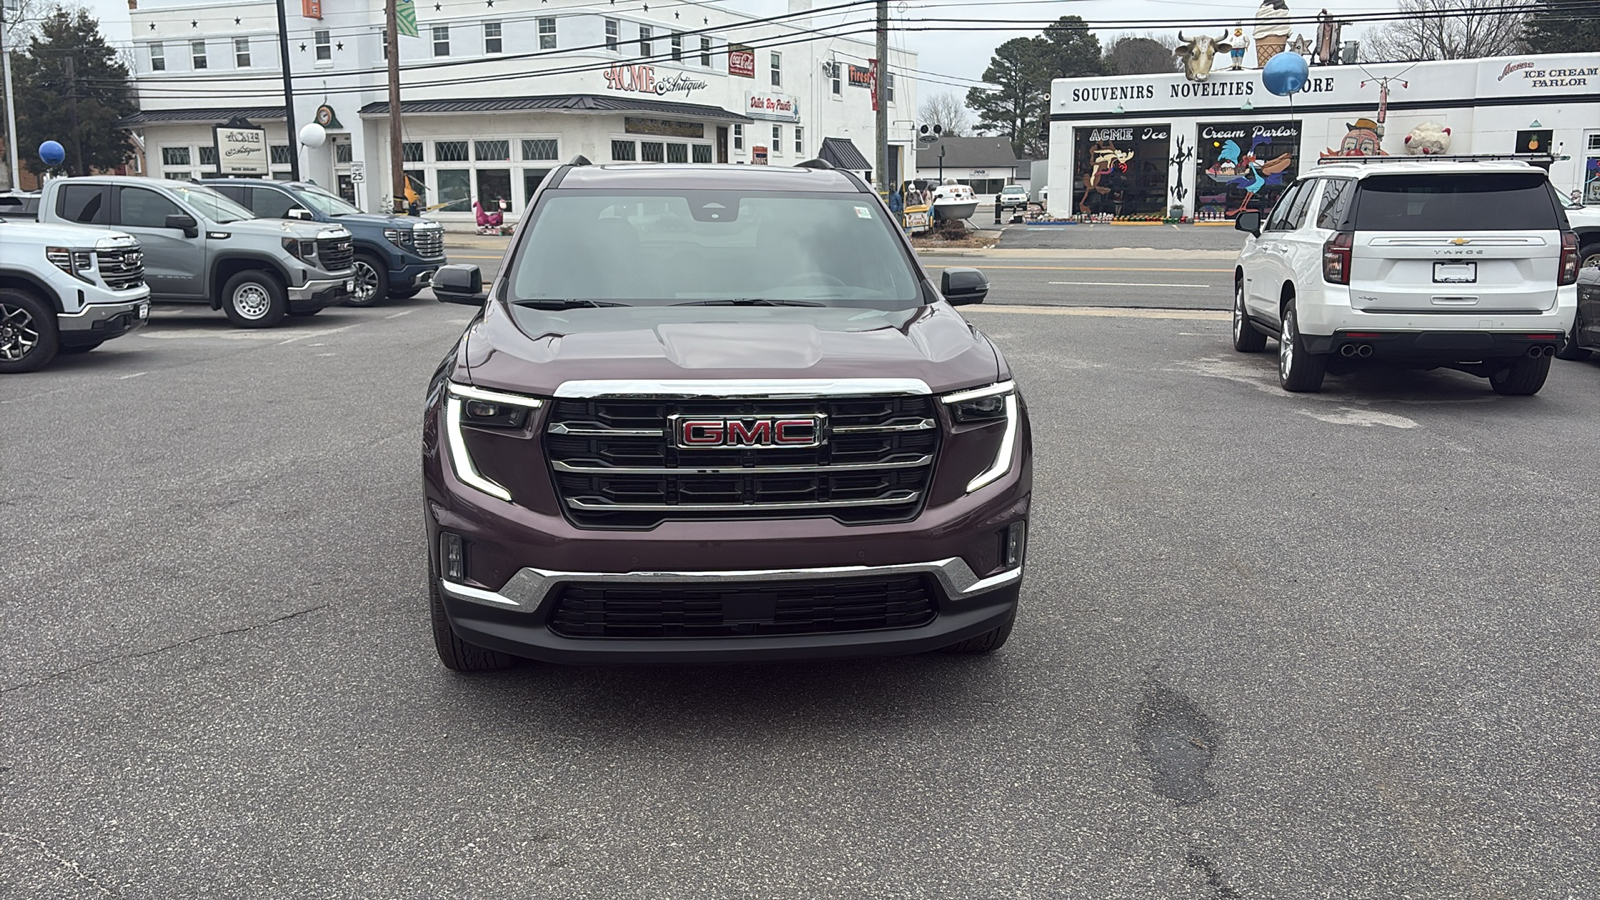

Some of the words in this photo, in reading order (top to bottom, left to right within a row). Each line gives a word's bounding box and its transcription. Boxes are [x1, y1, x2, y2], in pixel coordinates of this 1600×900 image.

[603, 62, 656, 94] ACME
[655, 71, 708, 98] Antiques
[849, 65, 871, 84] Firest
[1524, 70, 1545, 78] ICE
[1549, 67, 1598, 77] CREAM
[1073, 84, 1154, 102] SOUVENIRS
[1170, 81, 1254, 98] NOVELTIES
[1301, 77, 1334, 93] ORE
[1532, 78, 1587, 88] PARLOR
[750, 96, 764, 109] Dutch
[766, 97, 776, 112] Boy
[776, 98, 792, 112] Paints
[1089, 128, 1133, 141] ACME
[1141, 127, 1168, 140] Ice
[1202, 126, 1246, 139] Cream
[1252, 125, 1298, 138] Parlor
[352, 172, 364, 180] 25
[682, 419, 816, 446] GMC
